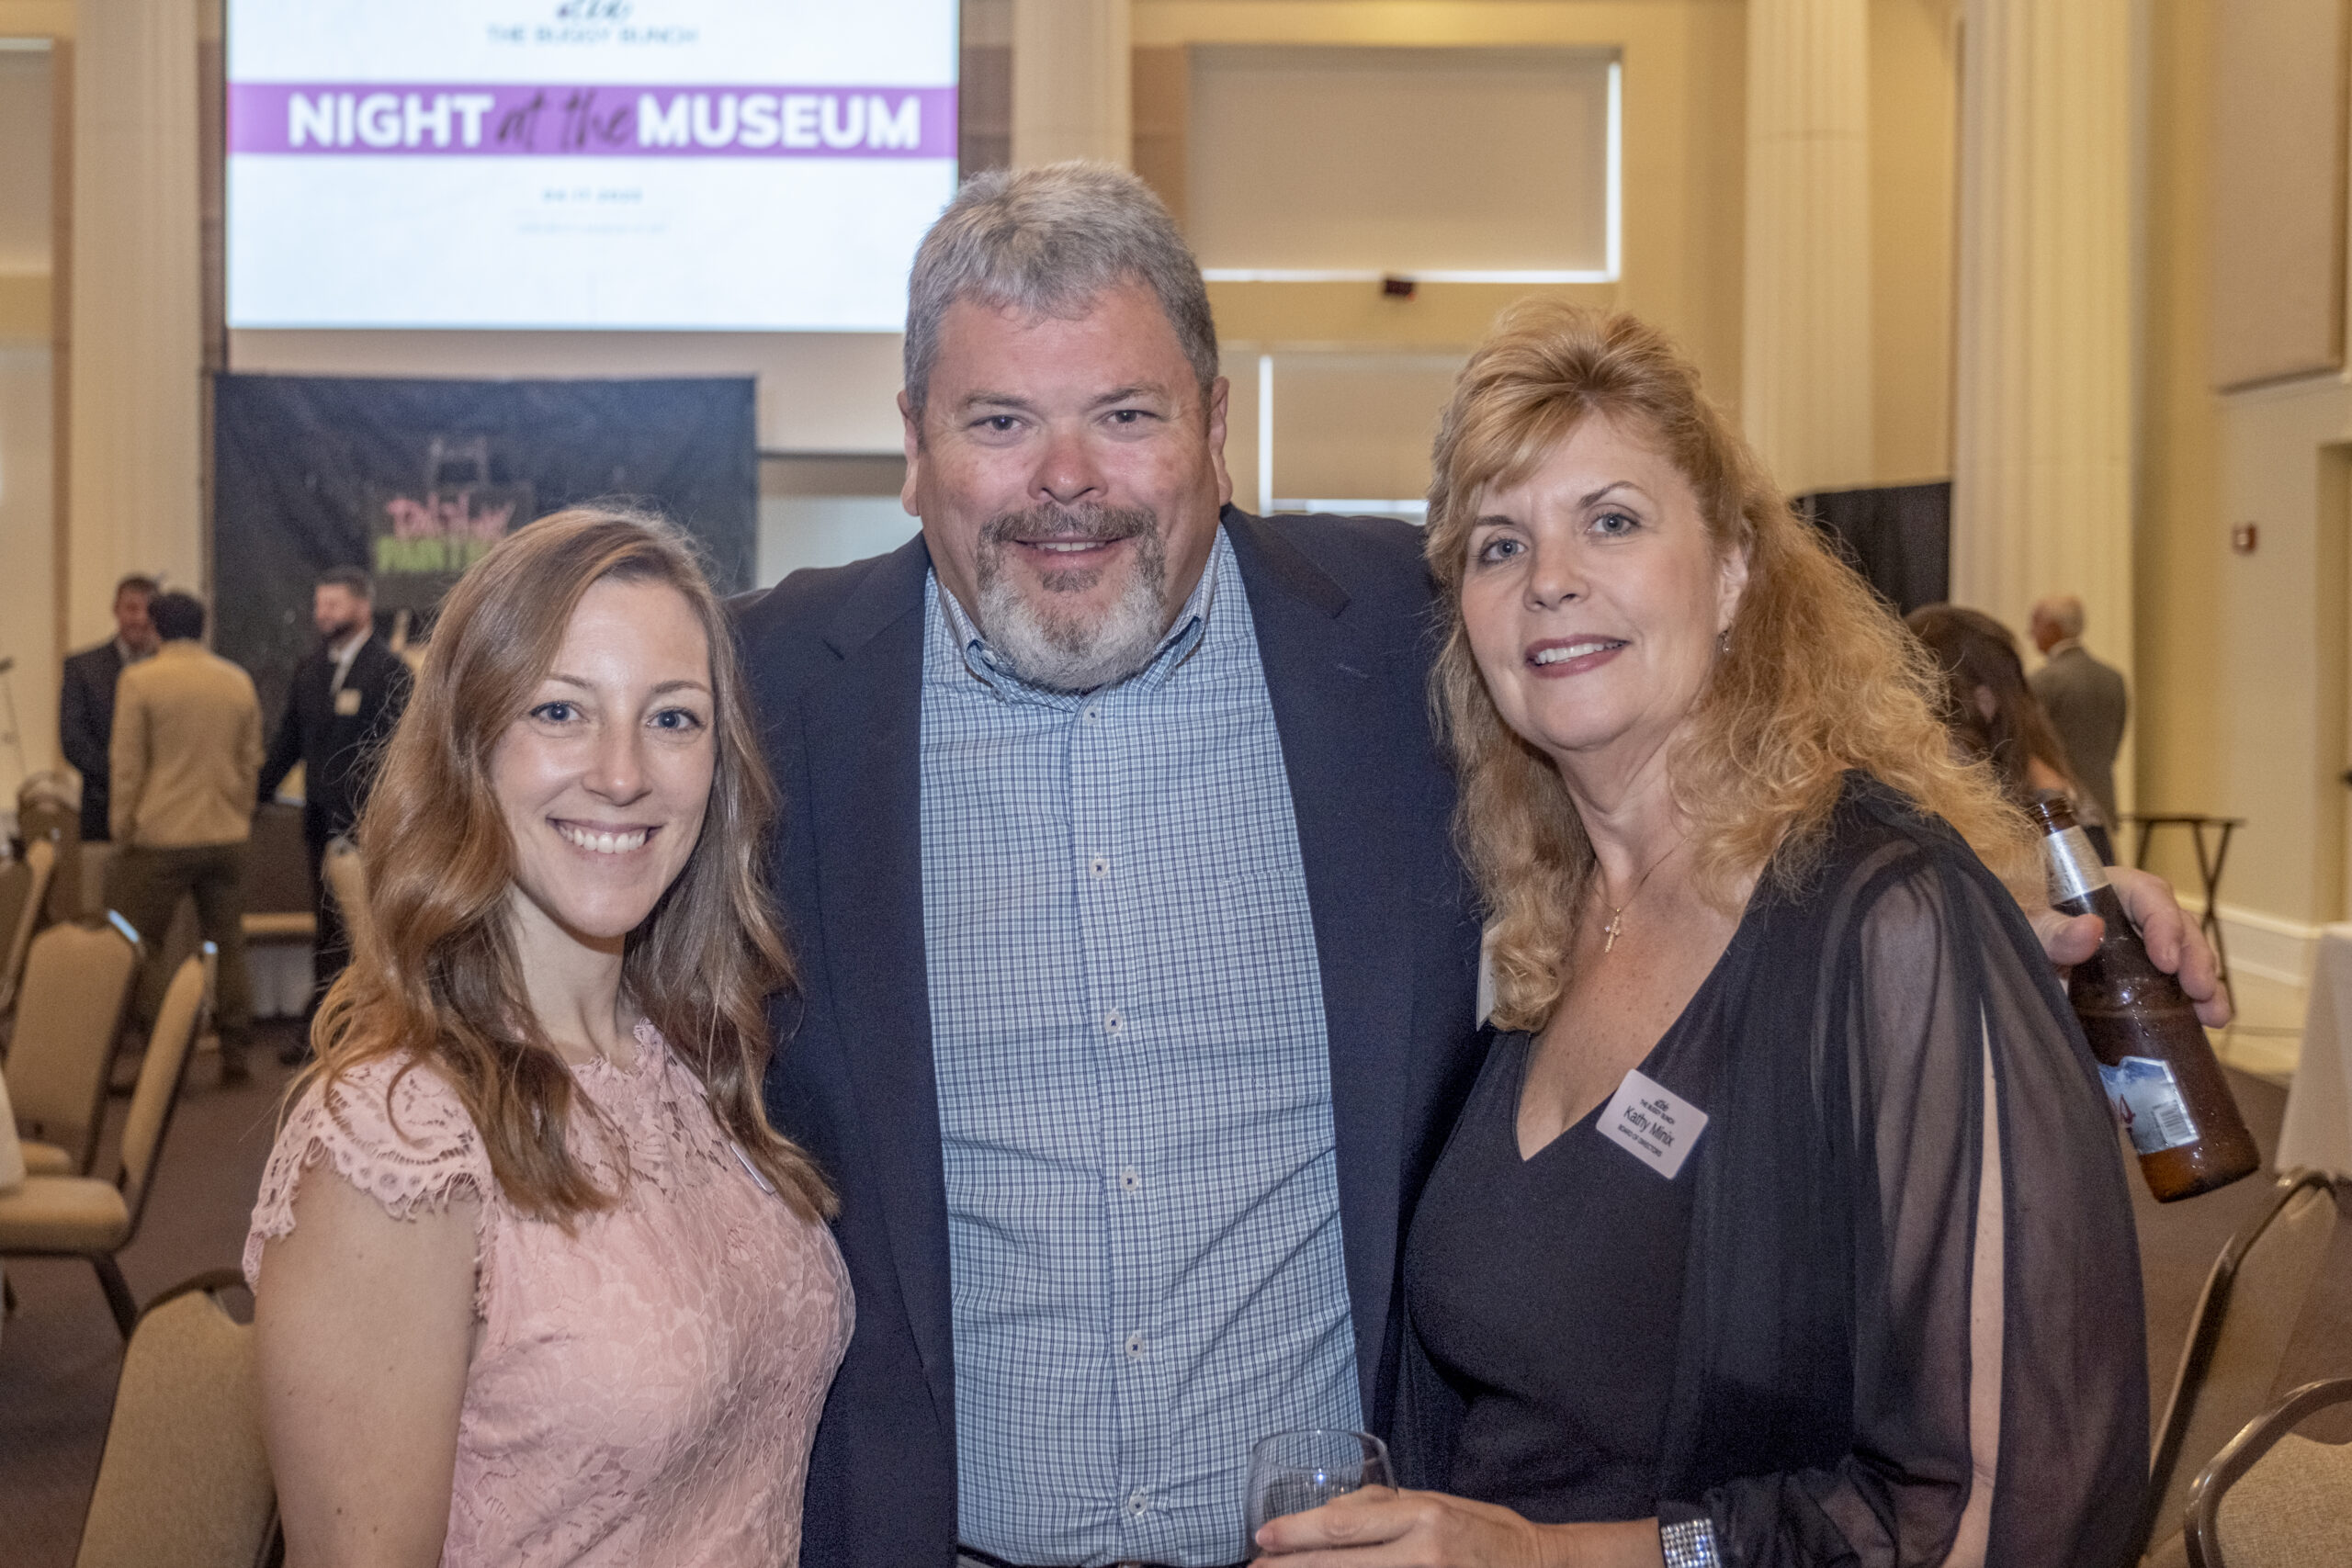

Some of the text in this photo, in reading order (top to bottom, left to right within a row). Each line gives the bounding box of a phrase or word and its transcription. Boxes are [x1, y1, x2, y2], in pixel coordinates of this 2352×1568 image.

[486, 24, 526, 42] THE
[288, 88, 922, 152] NIGHT at the MUSEUM
[1623, 1105, 1651, 1133] Kathy
[1649, 1122, 1676, 1147] Minix
